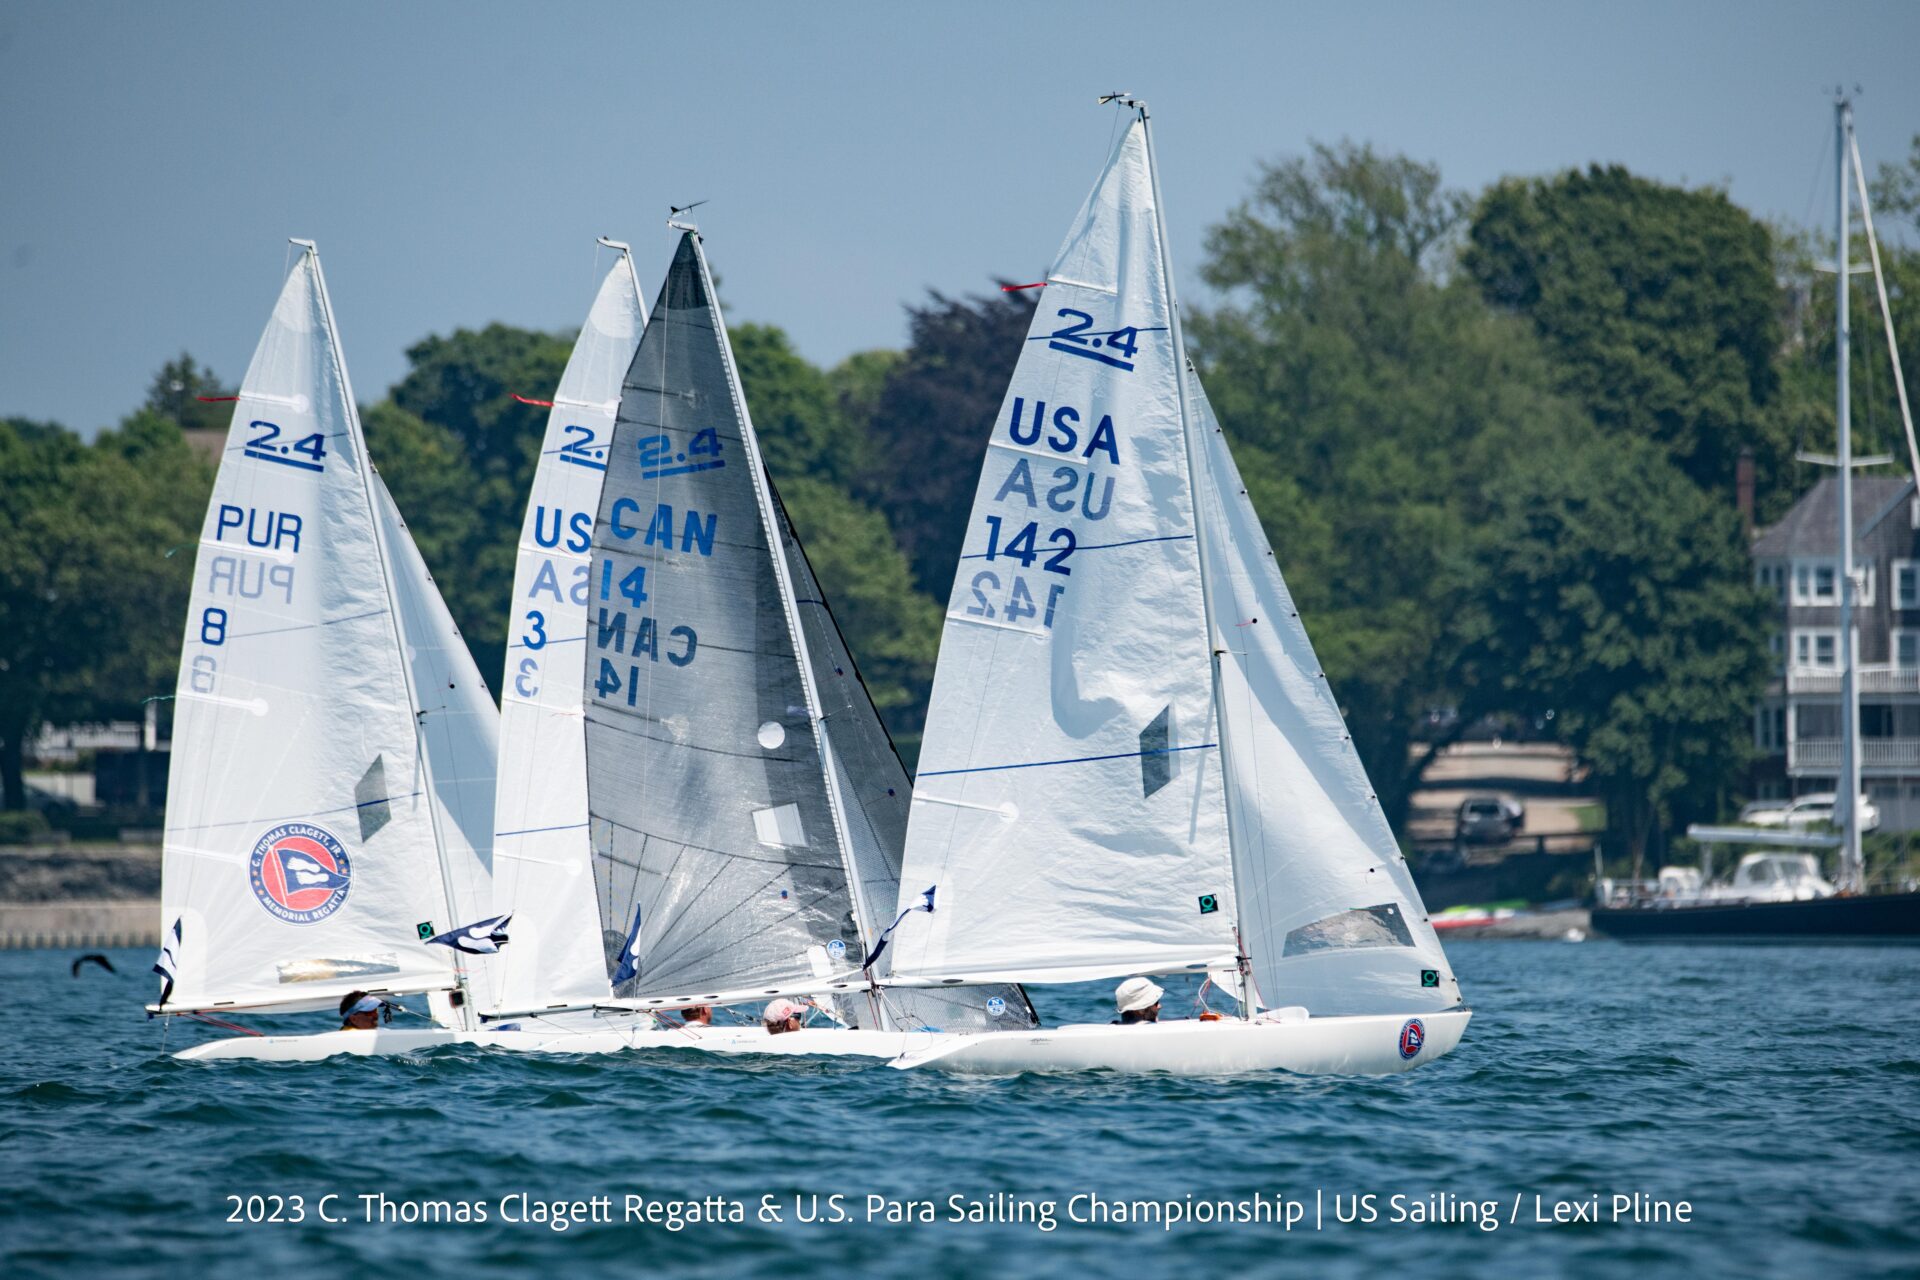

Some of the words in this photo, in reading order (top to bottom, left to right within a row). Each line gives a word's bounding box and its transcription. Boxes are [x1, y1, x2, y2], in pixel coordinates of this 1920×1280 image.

[1051, 308, 1138, 358] 2.4
[246, 420, 326, 461] 2.4
[561, 425, 604, 459] 2.
[637, 427, 723, 468] 2.4
[1009, 397, 1120, 465] USA
[216, 504, 303, 553] PUR
[534, 505, 593, 553] US
[610, 497, 717, 557] CAN
[986, 515, 1077, 576] 142
[601, 559, 648, 608] 14
[201, 607, 227, 646] 8
[522, 610, 547, 650] 3
[256, 828, 287, 856] THOMAS
[263, 896, 311, 922] MEMORIAL
[312, 889, 346, 920] REGATTA
